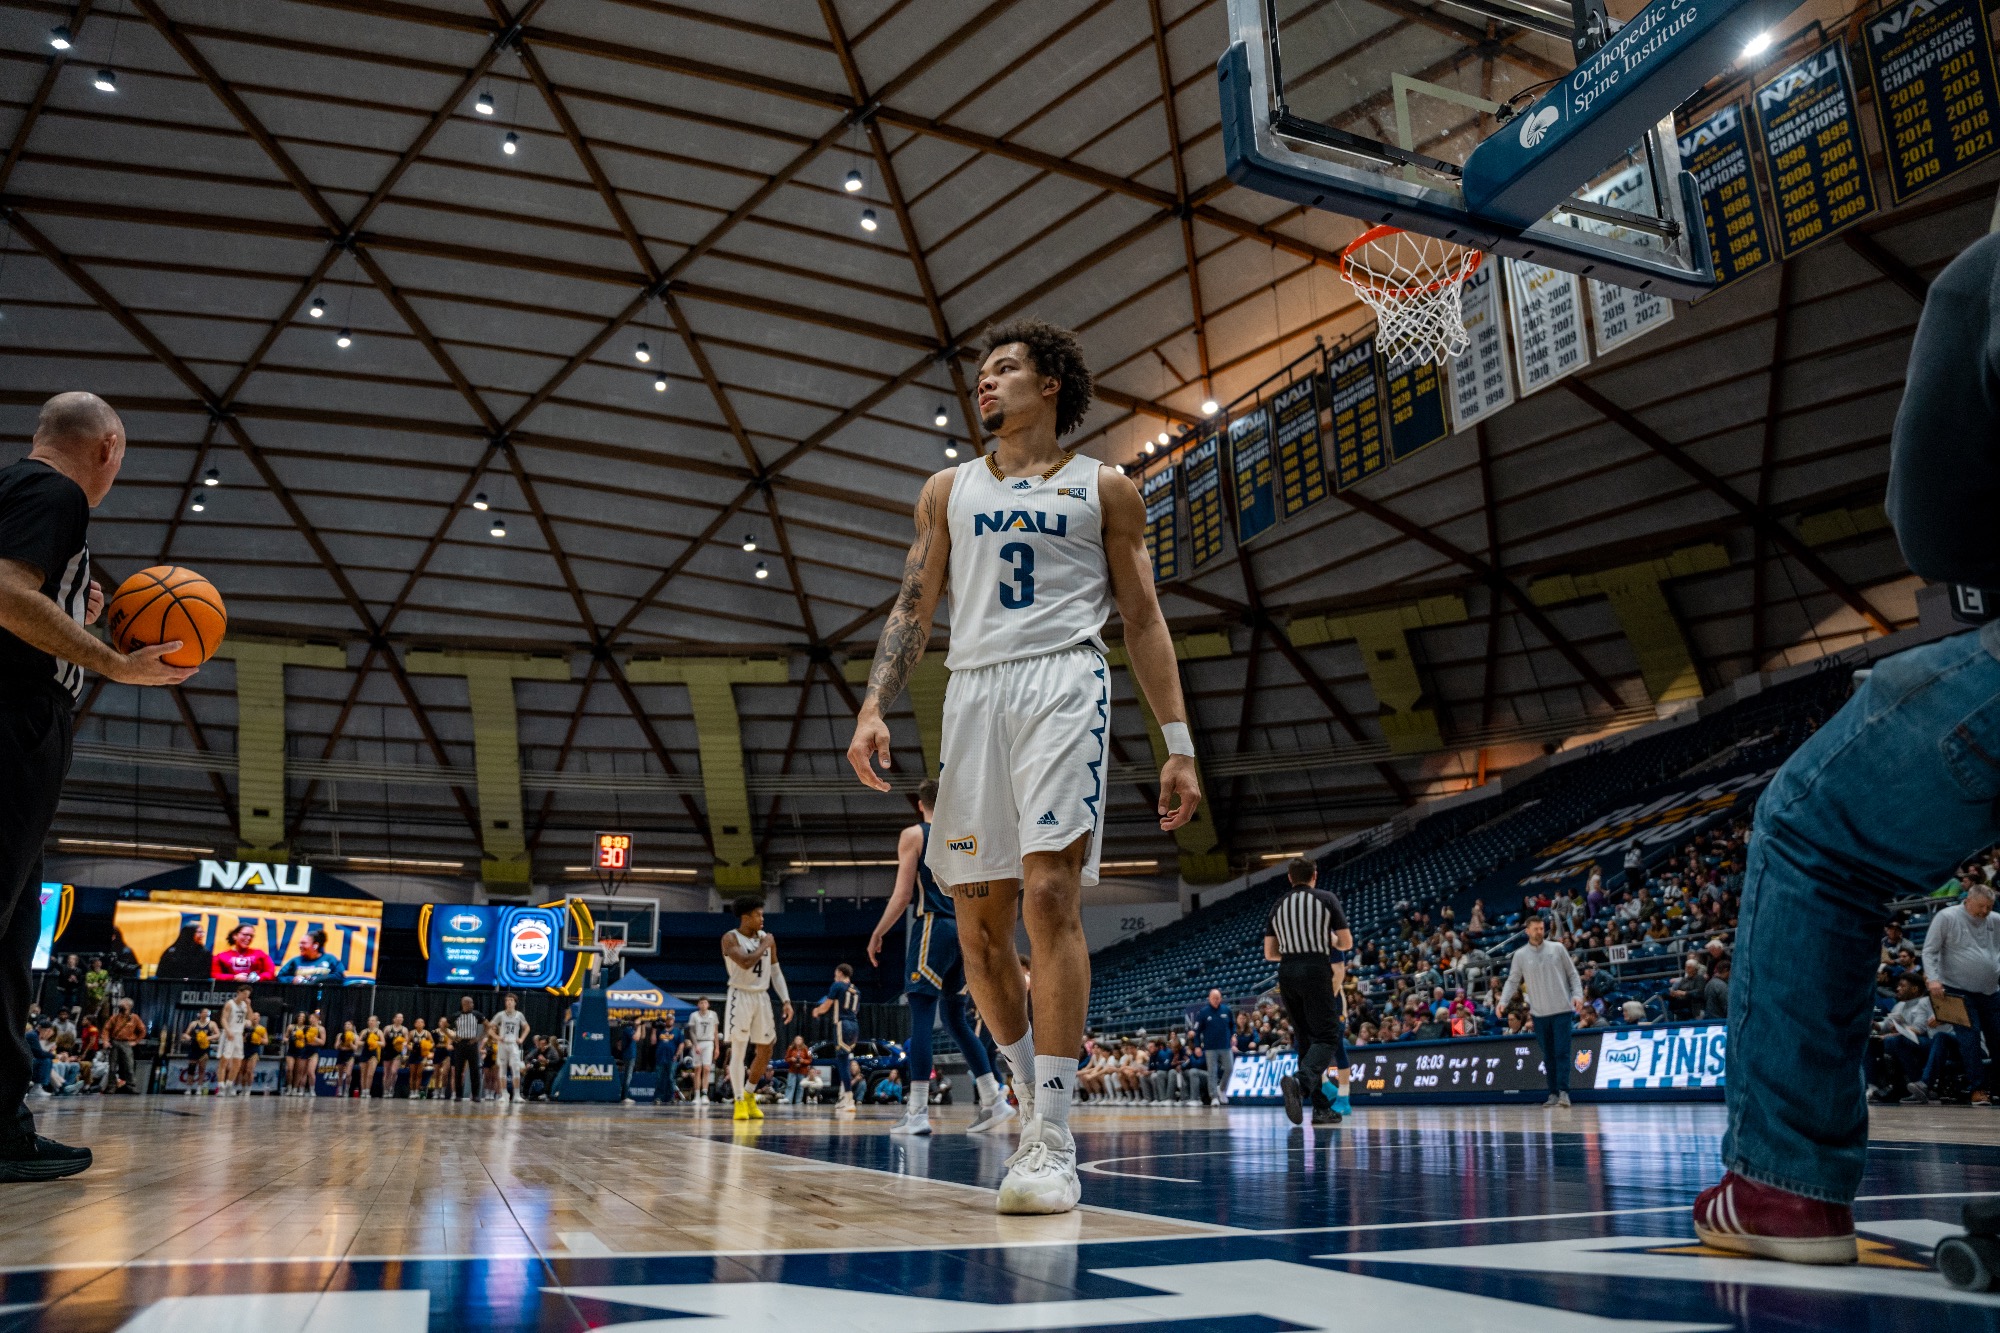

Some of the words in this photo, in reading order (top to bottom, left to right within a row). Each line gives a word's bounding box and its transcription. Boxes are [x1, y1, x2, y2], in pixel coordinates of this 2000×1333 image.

[1871, 0, 1950, 45] NA
[1929, 16, 1973, 49] SEASON
[1573, 4, 1666, 91] Orthopedic
[1574, 70, 1619, 115] Spine
[1622, 7, 1697, 75] Institute
[1882, 28, 1976, 93] CHAMPIONS
[1760, 48, 1838, 111] NAU
[1889, 80, 1926, 109] 2010
[1941, 50, 1976, 81] 2011
[1808, 89, 1845, 118] SEASON
[1893, 98, 1929, 128] 2012
[1943, 69, 1980, 101] 2013
[1770, 100, 1847, 156] CHAMPIONS
[1896, 118, 1932, 149] 2014
[1946, 89, 1984, 121] 2016
[1901, 138, 1934, 168] 2017
[1951, 109, 1989, 140] 2018
[1778, 162, 1812, 190] 2000
[1820, 138, 1853, 167] 2001
[1904, 158, 1940, 188] 2019
[1955, 130, 1994, 161] 2021
[1700, 158, 1746, 195] MPIONS
[1782, 180, 1815, 208] 2003
[1822, 156, 1857, 187] 2004
[1785, 199, 1819, 227] 2005
[1826, 175, 1860, 205] 2007
[1460, 266, 1489, 298] AU
[1635, 302, 1661, 325] 2022
[1330, 342, 1371, 379] NAU
[1274, 378, 1312, 413] NAU
[1334, 382, 1375, 414] CHAMPIONS
[1233, 408, 1267, 441] NAU
[1185, 439, 1216, 470] NAU
[1069, 488, 1085, 497] SKY
[1144, 467, 1174, 496] NAU
[974, 510, 1067, 538] NAU
[999, 542, 1034, 610] 3
[600, 847, 624, 867] 30
[950, 841, 974, 851] NAU
[198, 859, 312, 894] NAU
[1121, 917, 1145, 930] 226
[515, 942, 546, 950] PEPSI
[1611, 947, 1626, 960] 116
[181, 990, 211, 1004] COLD
[613, 993, 657, 1002] NAU
[570, 1063, 613, 1076] NAU
[1374, 1065, 1382, 1076] 2
[1396, 1063, 1408, 1072] TF
[1415, 1054, 1445, 1070] 18:03
[1471, 1057, 1479, 1067] F
[1486, 1058, 1500, 1068] TF
[1516, 1059, 1524, 1070] 3
[1608, 1053, 1636, 1063] NAU
[1394, 1075, 1402, 1088] 0
[1413, 1075, 1438, 1086] 2ND
[1452, 1071, 1460, 1085] 3
[1471, 1070, 1478, 1083] 1
[1486, 1072, 1494, 1085] 0
